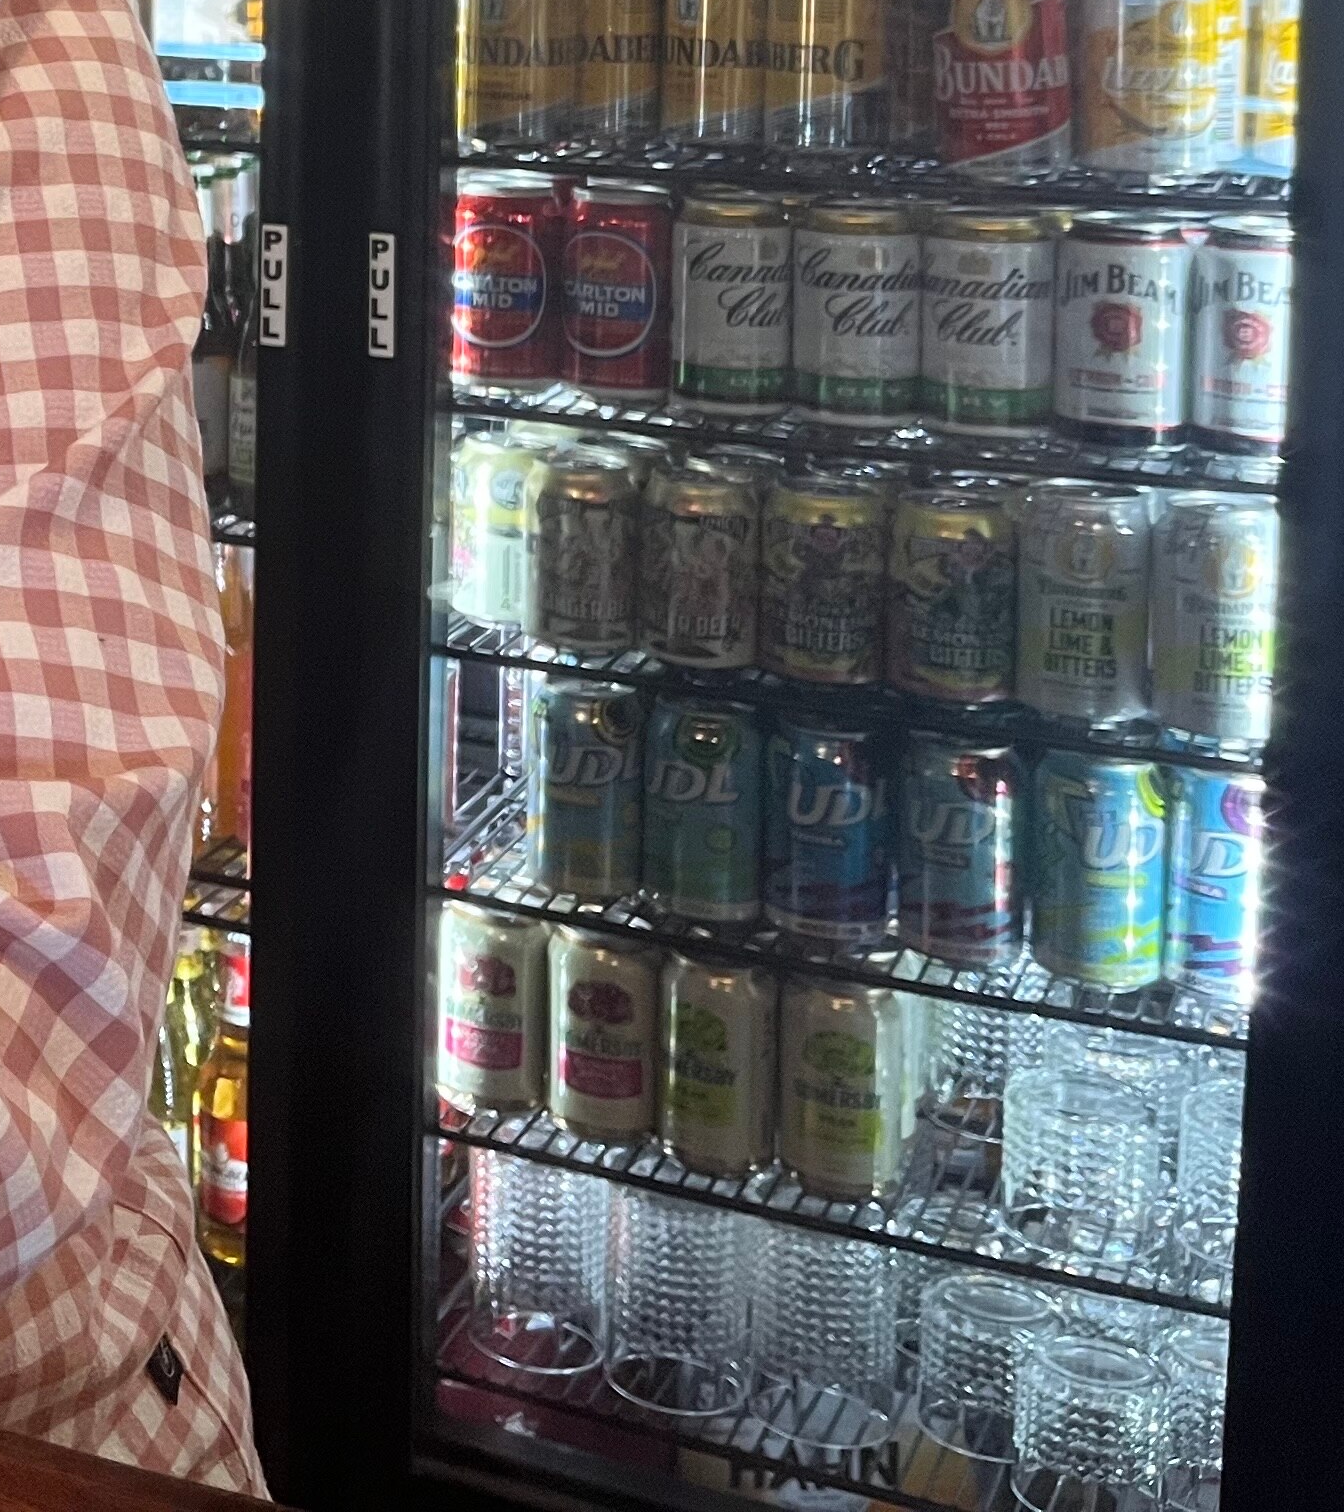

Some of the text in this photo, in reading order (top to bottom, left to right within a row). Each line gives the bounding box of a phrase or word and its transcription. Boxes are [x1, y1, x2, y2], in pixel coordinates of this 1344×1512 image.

[262, 230, 284, 341] PULL
[370, 239, 391, 351] PULL
[472, 292, 512, 309] MID
[1236, 270, 1292, 306] BEA
[579, 300, 620, 318] MID
